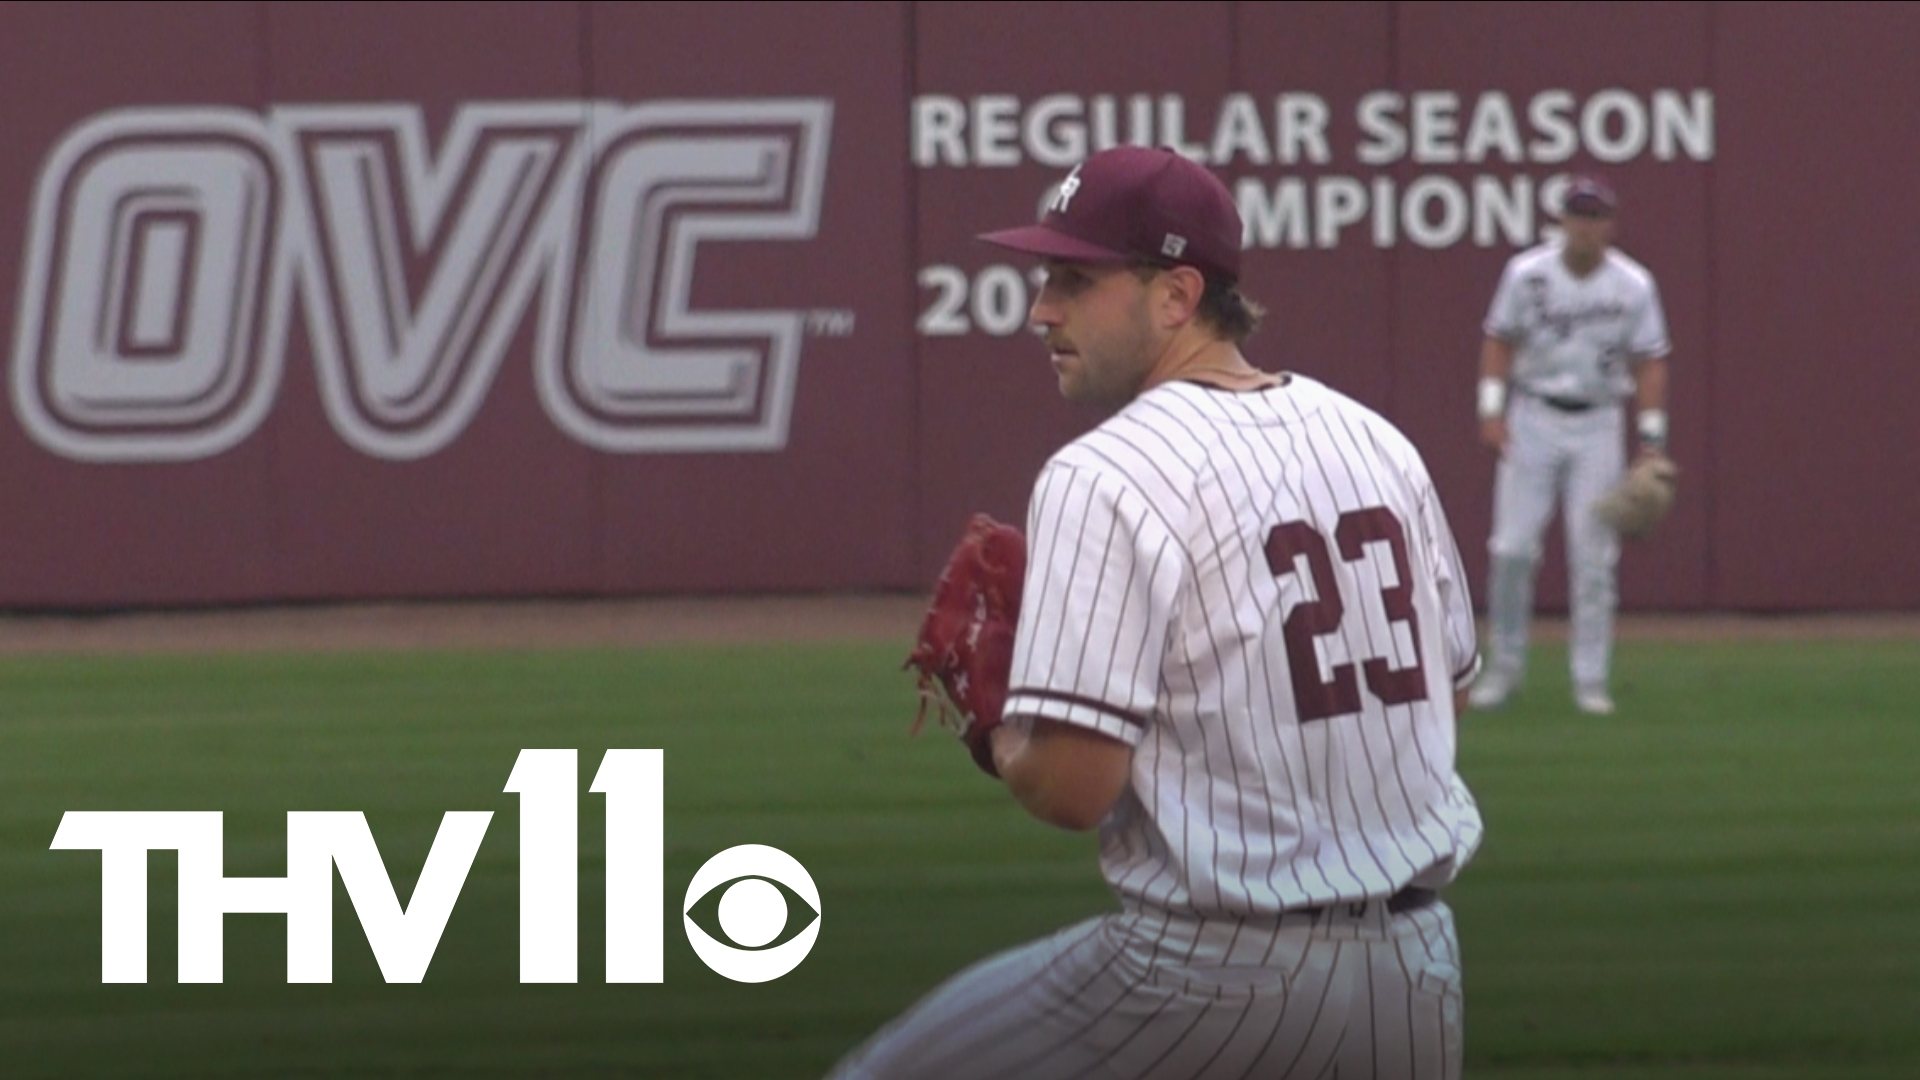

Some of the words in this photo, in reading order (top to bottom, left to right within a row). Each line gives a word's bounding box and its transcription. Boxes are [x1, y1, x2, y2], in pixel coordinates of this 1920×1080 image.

[911, 94, 1331, 166] REGULAR
[1356, 89, 1715, 163] SEASON
[12, 98, 834, 462] OVC
[1264, 506, 1428, 722] 23
